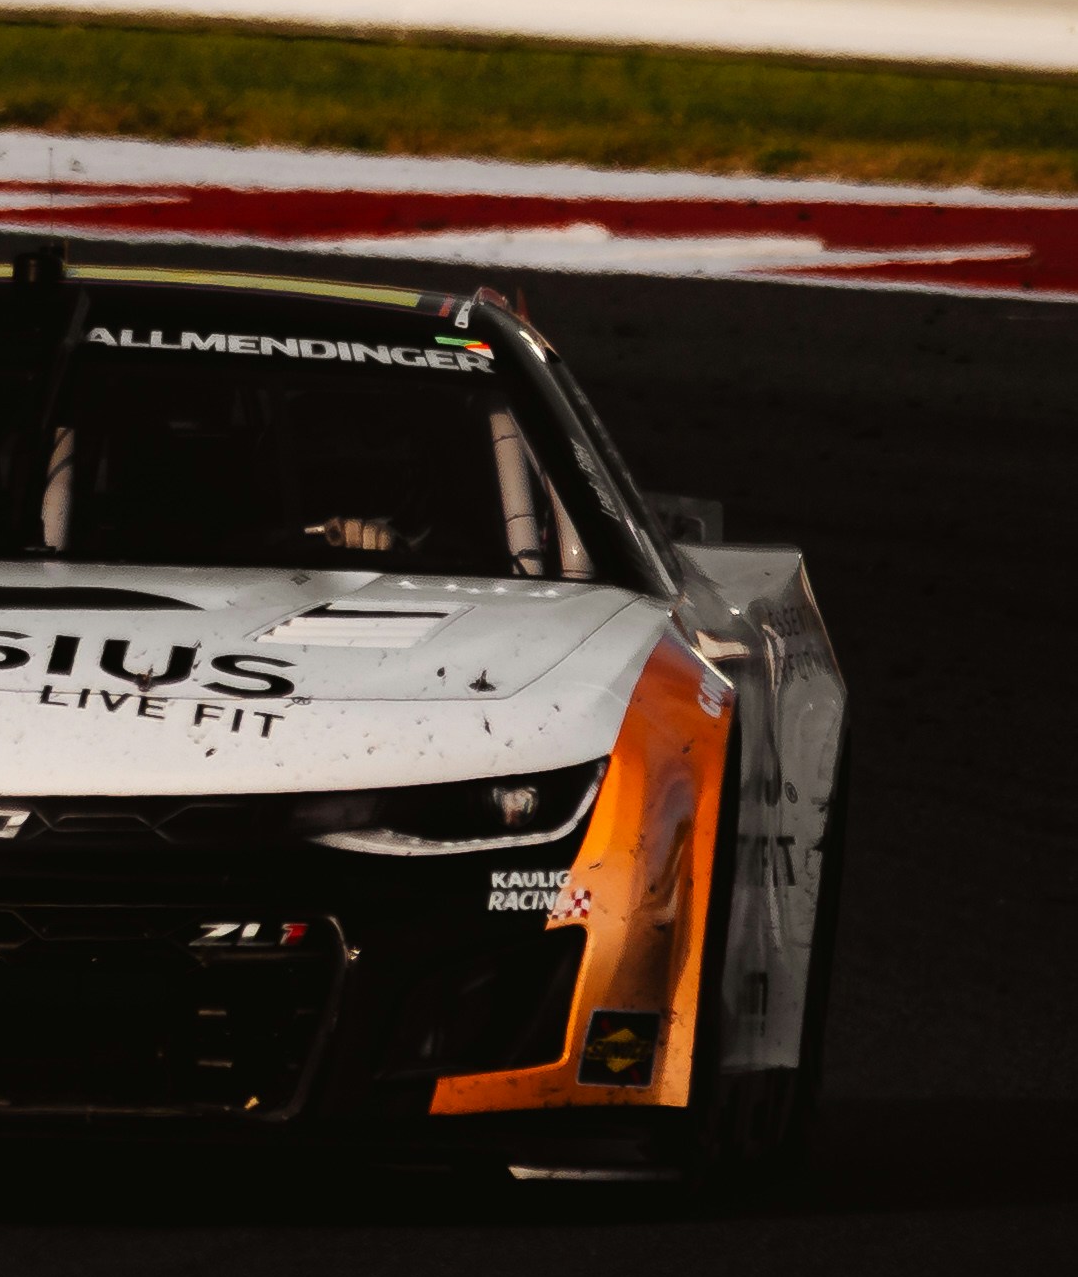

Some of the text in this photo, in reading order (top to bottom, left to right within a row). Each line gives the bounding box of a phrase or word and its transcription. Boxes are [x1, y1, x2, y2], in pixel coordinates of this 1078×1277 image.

[86, 326, 495, 374] ALLMENDINGER
[39, 684, 285, 738] LIVE FIT
[490, 869, 571, 889] KAULIG
[188, 923, 308, 946] ZL1
